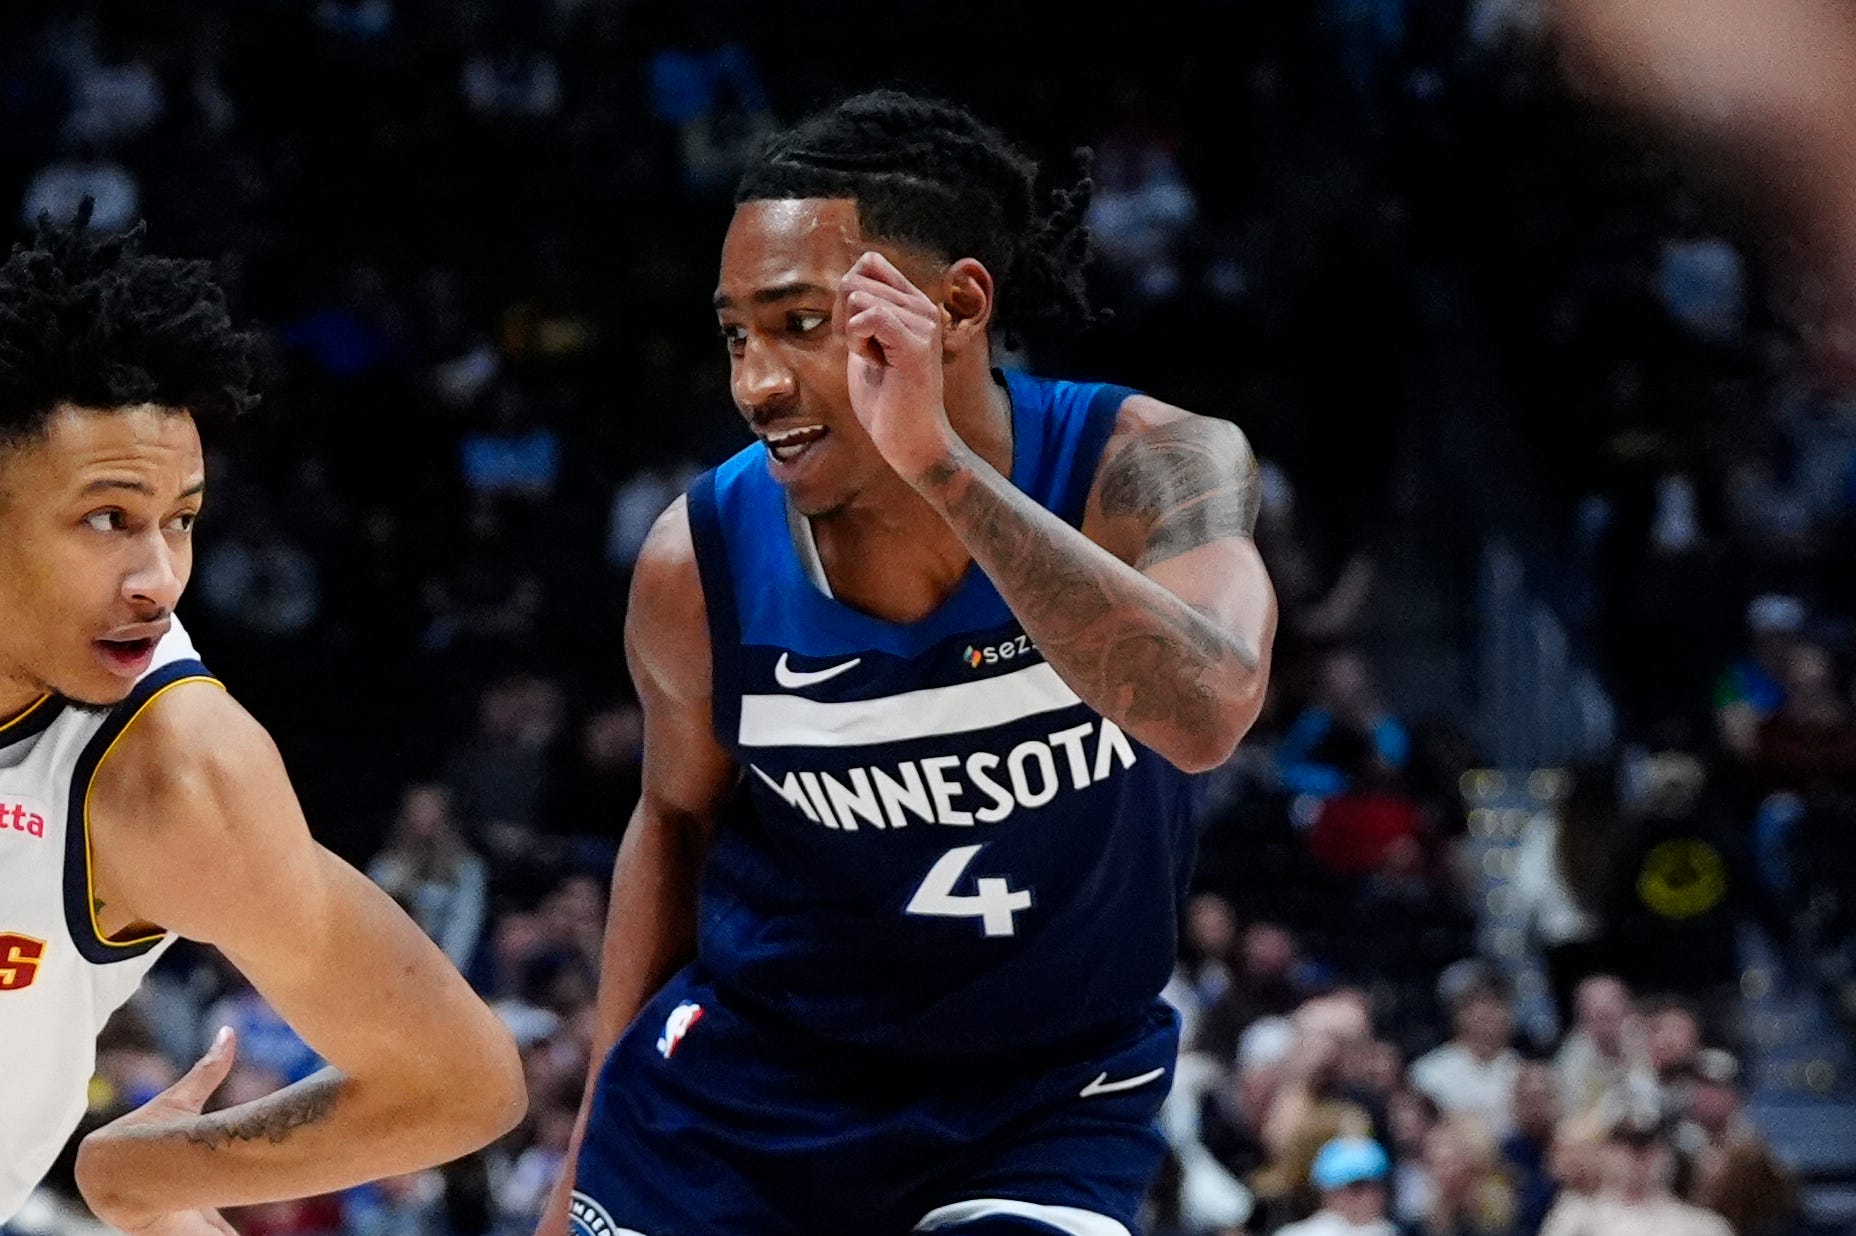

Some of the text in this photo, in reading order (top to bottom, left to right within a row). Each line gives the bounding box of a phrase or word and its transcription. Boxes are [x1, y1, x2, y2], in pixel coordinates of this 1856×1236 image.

[982, 634, 1037, 664] sez
[750, 717, 1137, 832] MINNESOTA
[904, 844, 1033, 939] 4
